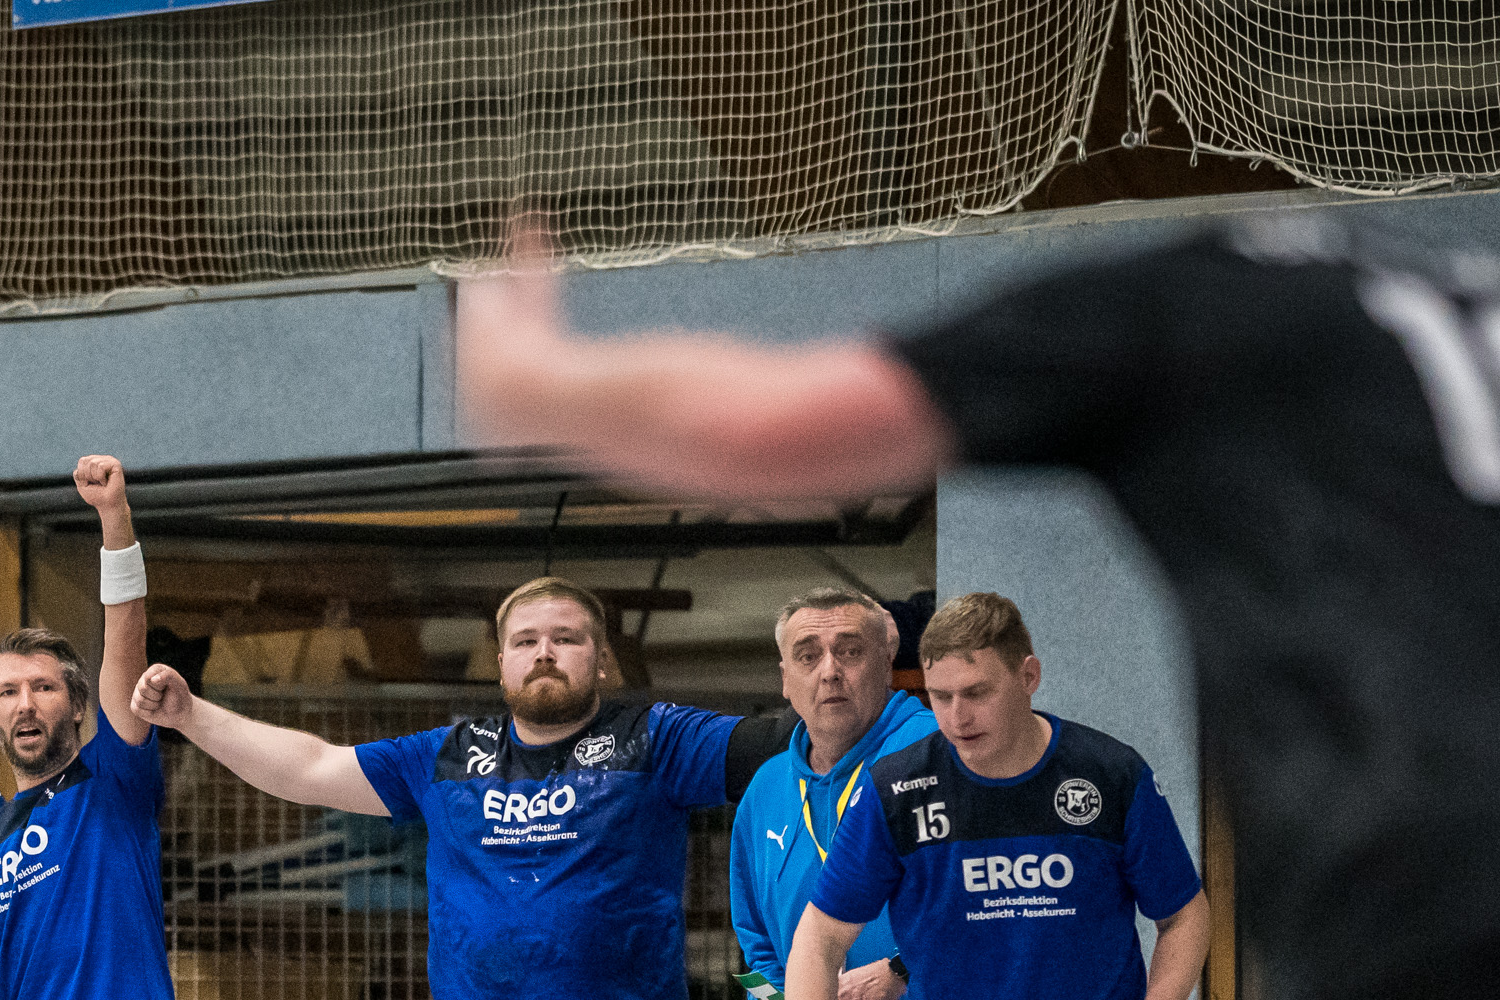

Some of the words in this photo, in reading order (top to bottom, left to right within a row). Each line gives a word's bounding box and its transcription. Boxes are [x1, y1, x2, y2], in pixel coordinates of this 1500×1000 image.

[891, 775, 938, 795] Kempa
[483, 784, 576, 823] ERGO
[912, 801, 951, 843] 15
[481, 836, 520, 845] Habenicht
[525, 832, 578, 843] Assekuranz
[17, 864, 61, 893] Assekuranz
[962, 853, 1074, 893] ERGO
[983, 895, 1058, 908] Bezirksdirektion
[966, 908, 1015, 921] Habenicht
[1022, 907, 1077, 918] Assekuranz
